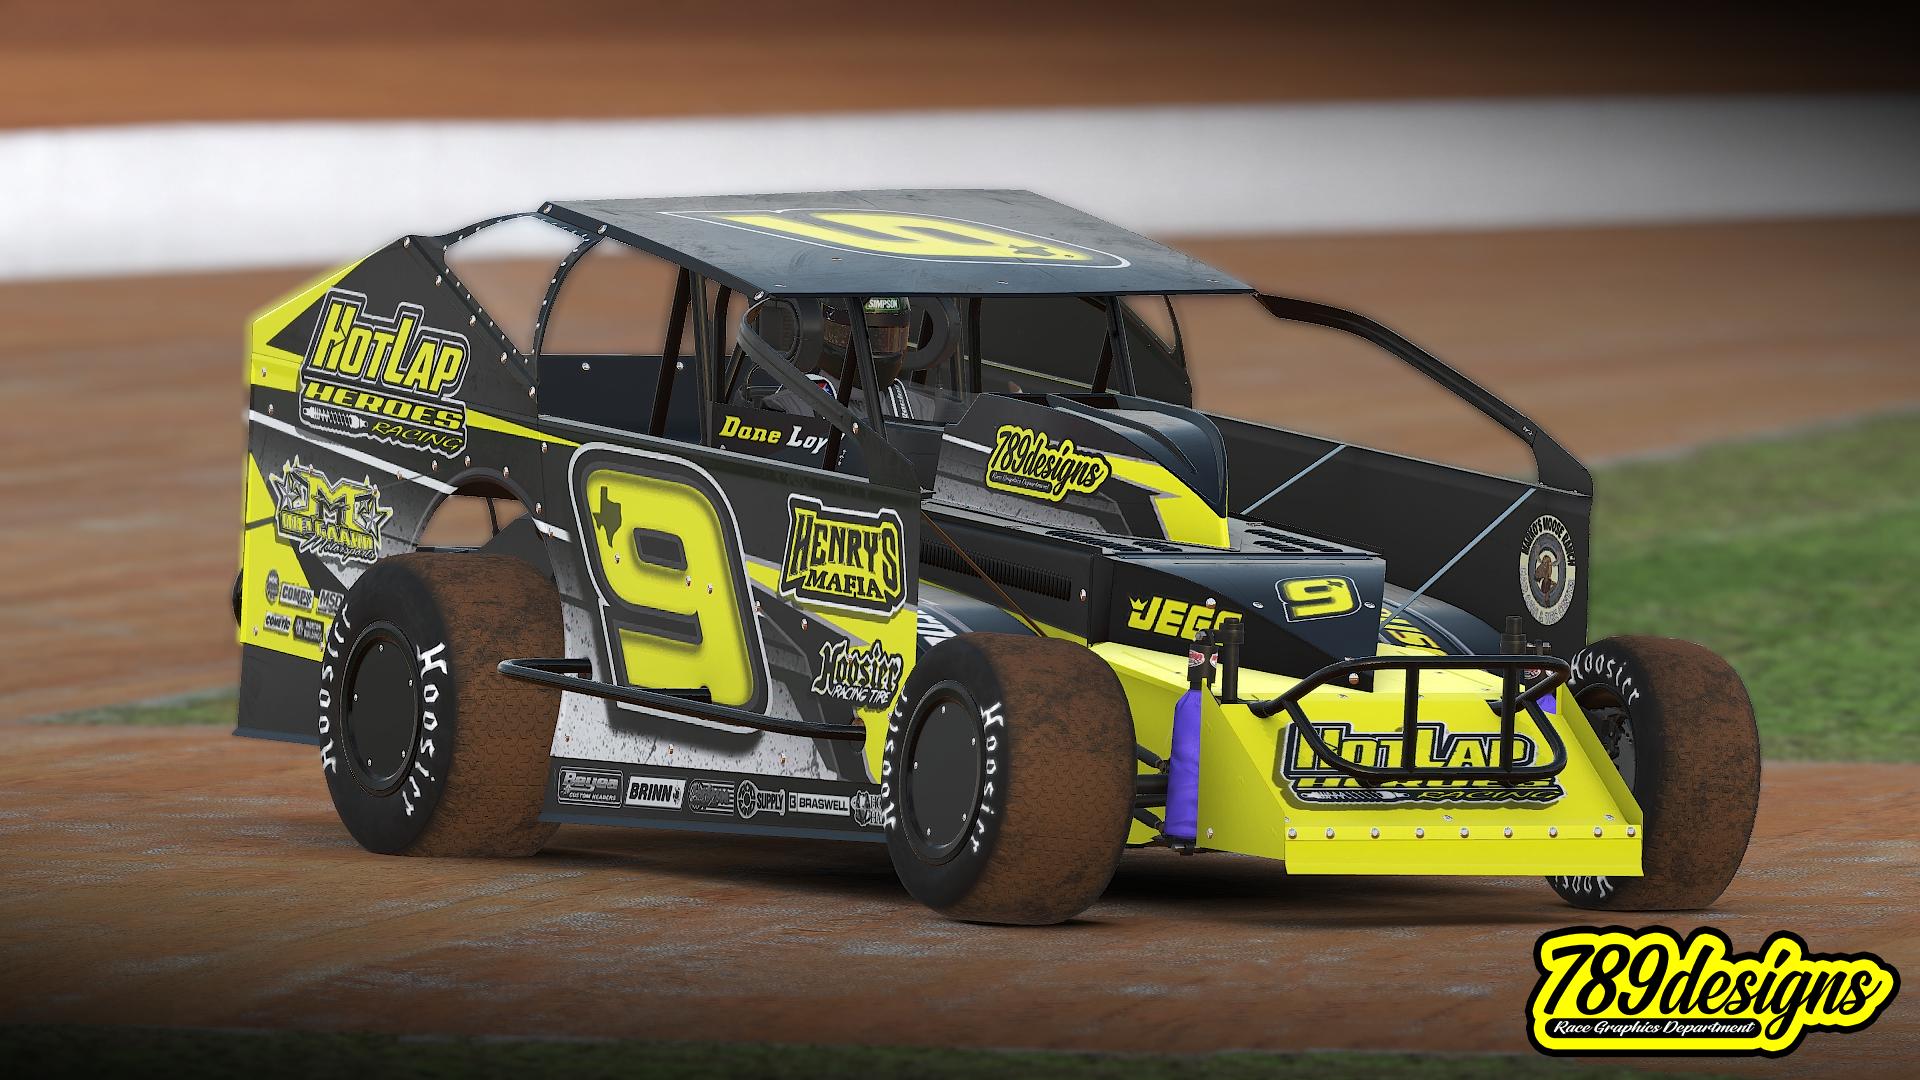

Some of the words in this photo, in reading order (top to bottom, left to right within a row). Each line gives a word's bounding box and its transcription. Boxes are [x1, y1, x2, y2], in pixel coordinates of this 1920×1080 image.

[867, 299, 898, 309] SIMPSON
[303, 380, 465, 430] HEROES
[371, 420, 464, 451] RACING
[718, 415, 782, 444] Dane
[785, 424, 829, 455] Loy
[991, 430, 1105, 496] 789designs
[1542, 516, 1565, 539] MOOSE
[789, 514, 899, 593] HENRY'S
[580, 462, 760, 714] 9
[804, 569, 884, 600] MAFIA
[1282, 577, 1356, 619] 9
[832, 684, 868, 702] RACING
[868, 689, 892, 705] TIRE
[402, 641, 449, 817] Hoosier
[628, 782, 673, 803] BRINN
[756, 791, 785, 811] SUPPLY
[799, 798, 849, 812] BRASWELL
